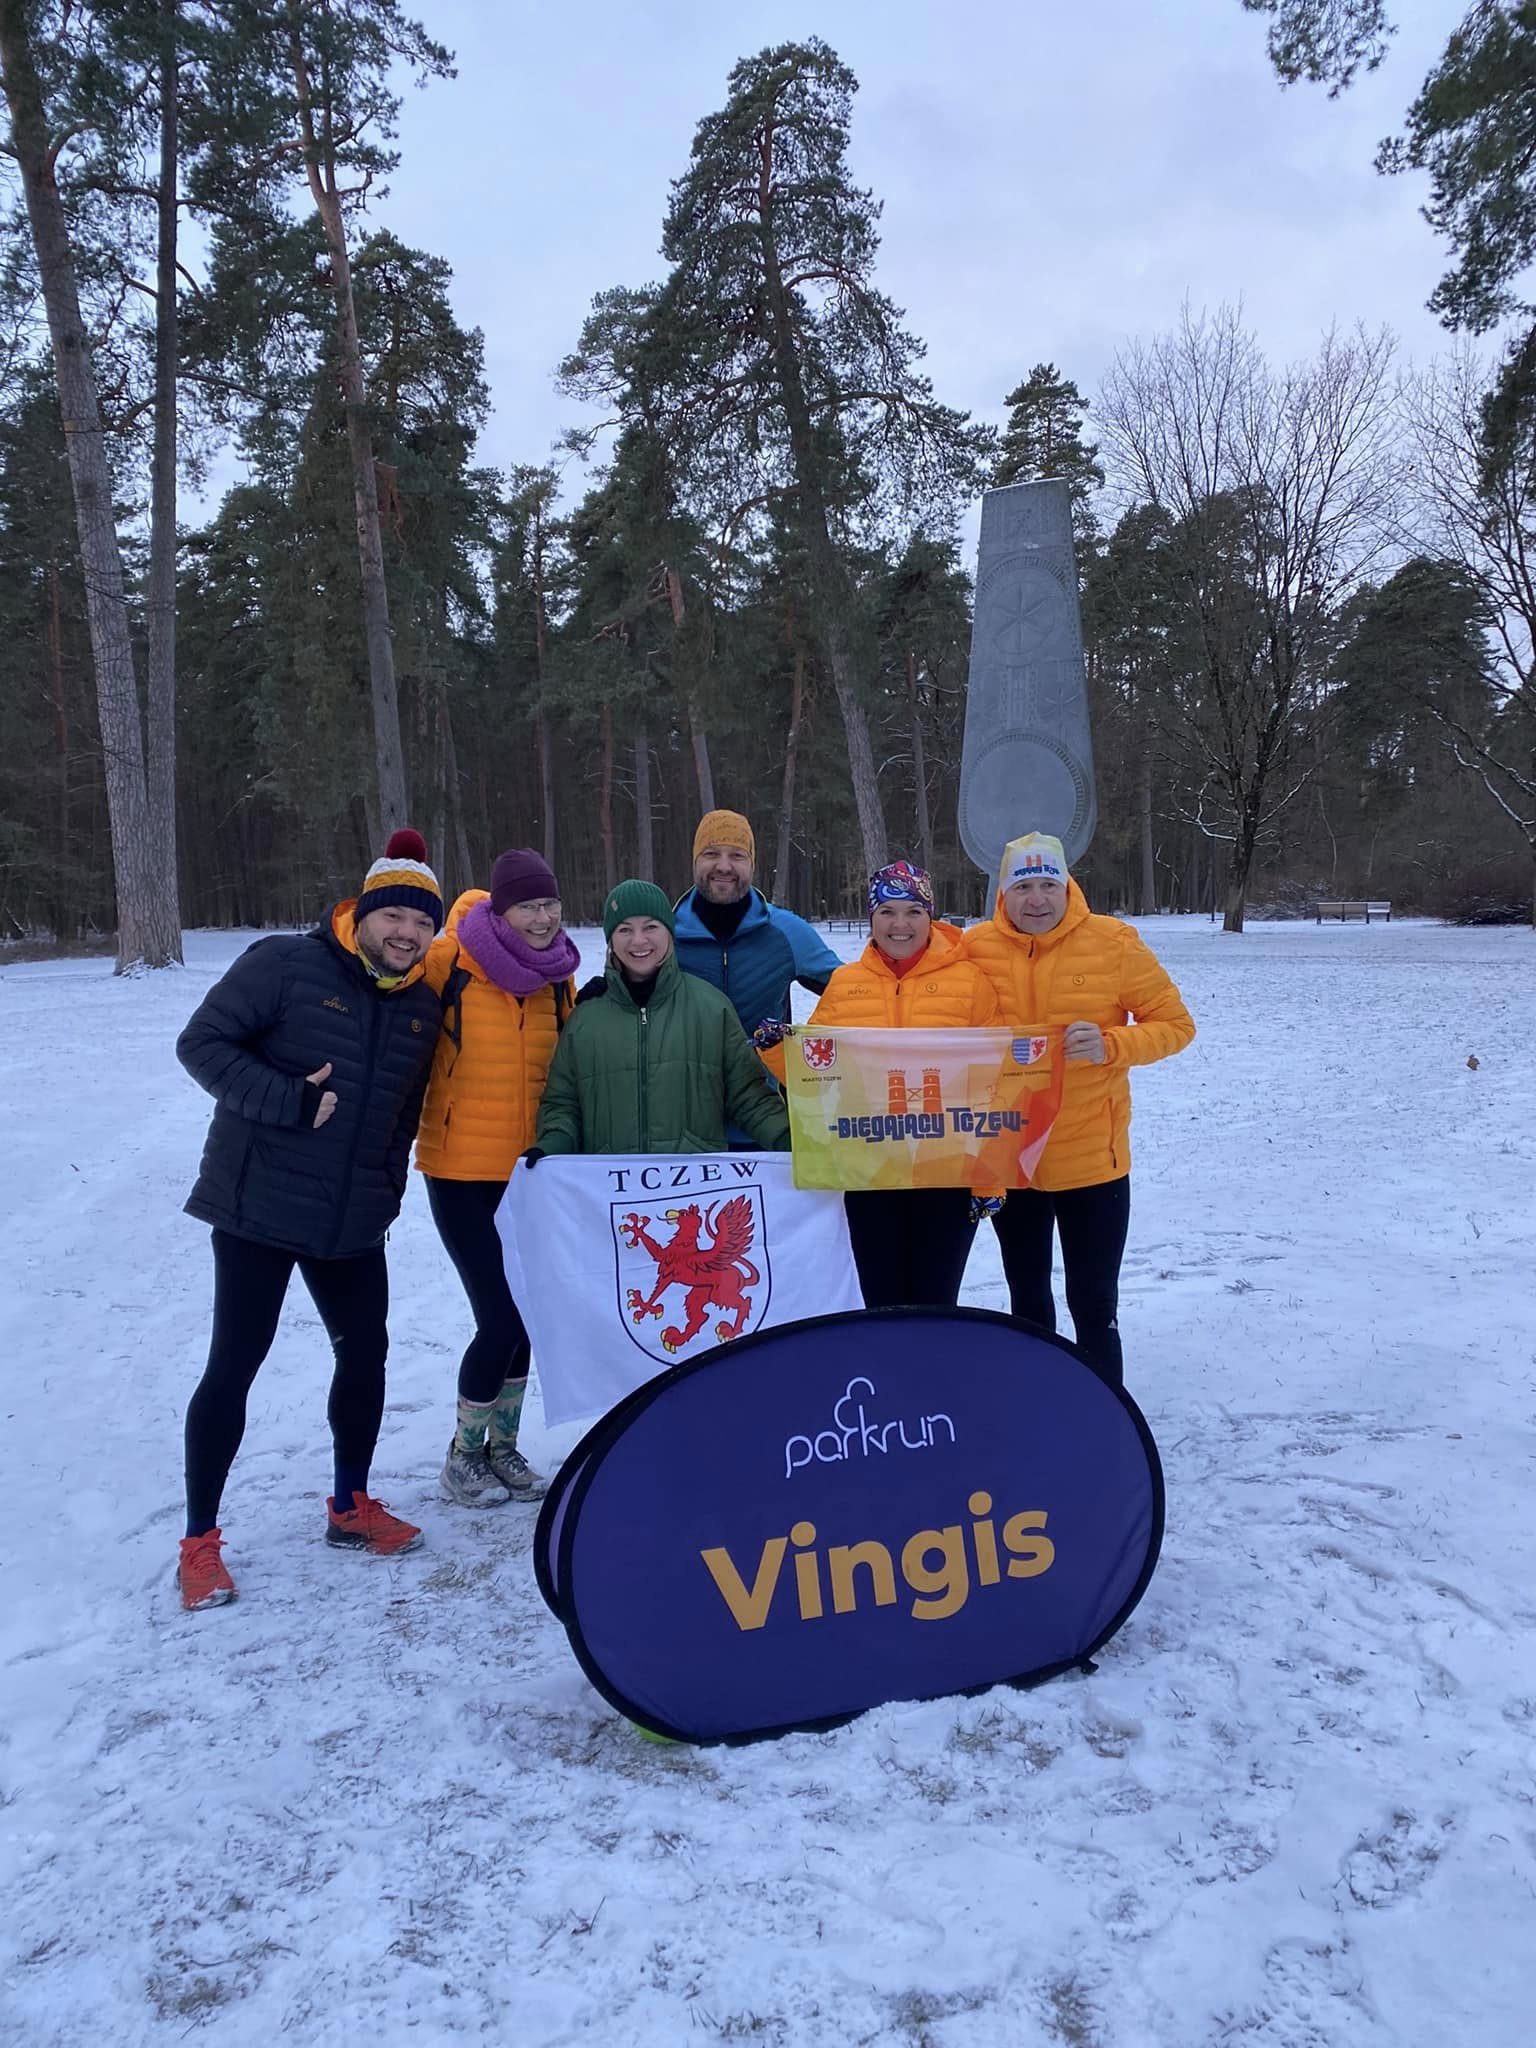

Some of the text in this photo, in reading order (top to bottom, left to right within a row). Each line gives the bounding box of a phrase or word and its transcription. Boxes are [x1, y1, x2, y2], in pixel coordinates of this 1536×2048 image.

[608, 1160, 759, 1193] TCZEW
[785, 1377, 956, 1479] parkrun
[700, 1491, 1056, 1632] Vingis
